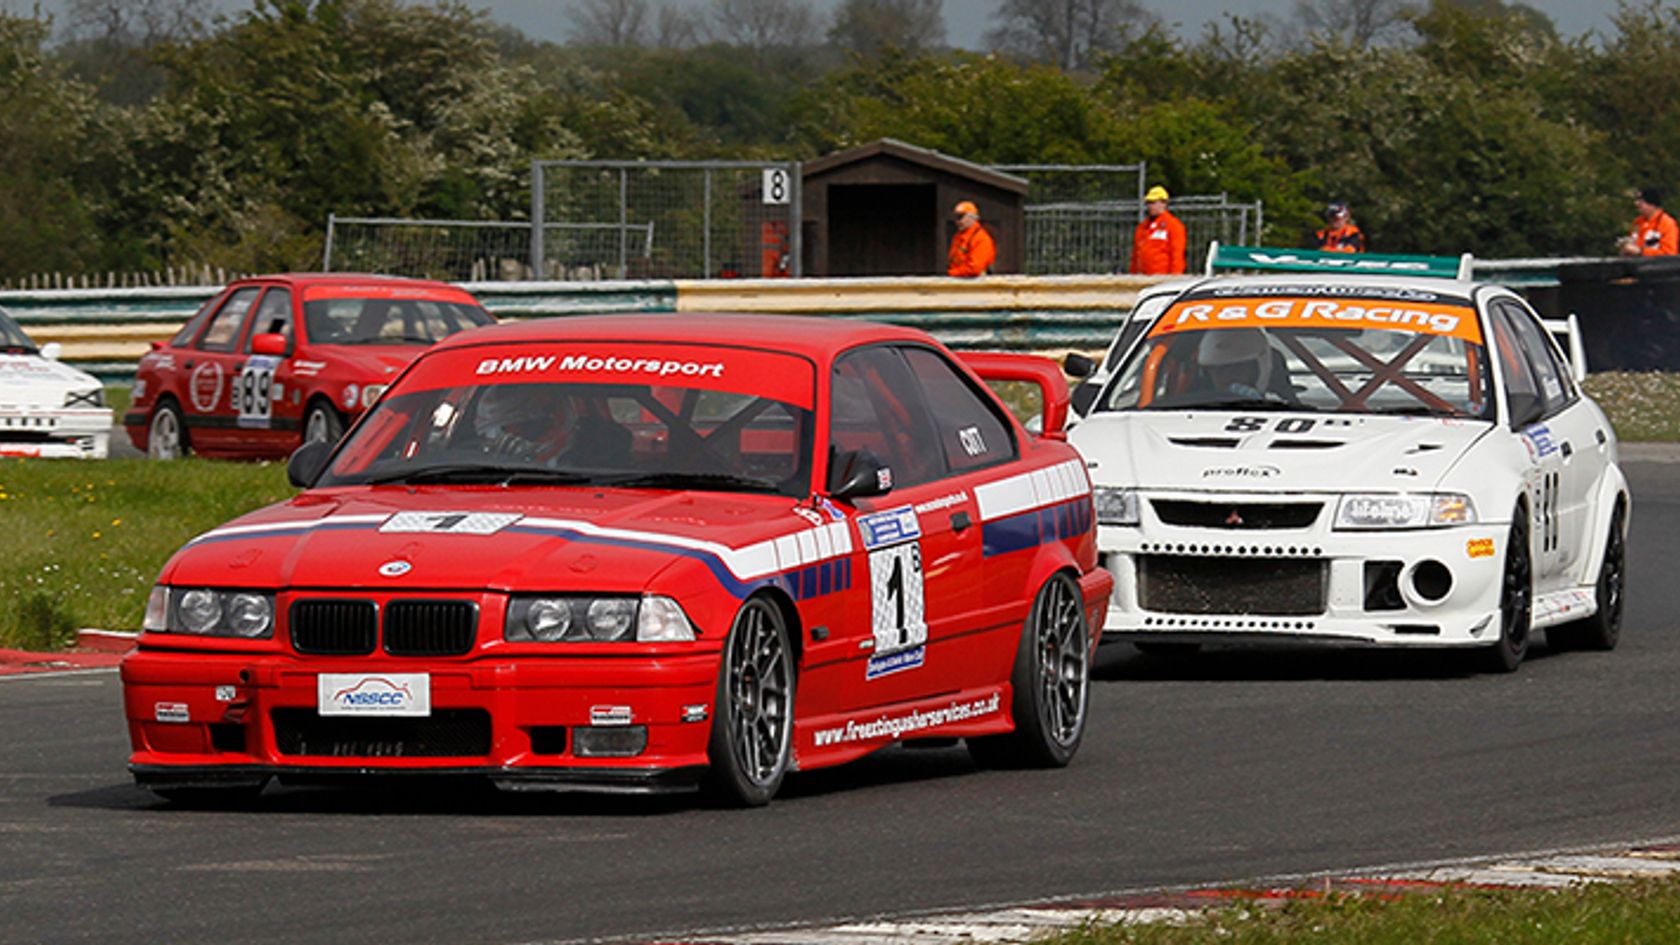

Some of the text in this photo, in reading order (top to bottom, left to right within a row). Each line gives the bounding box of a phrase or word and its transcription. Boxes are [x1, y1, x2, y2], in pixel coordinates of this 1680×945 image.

[771, 170, 785, 201] 8
[1176, 301, 1460, 331] R & G Racing
[476, 356, 724, 377] BMW Motorsport
[243, 369, 270, 415] 89
[1224, 416, 1316, 433] 80
[426, 514, 469, 530] 1
[886, 555, 908, 644] 1
